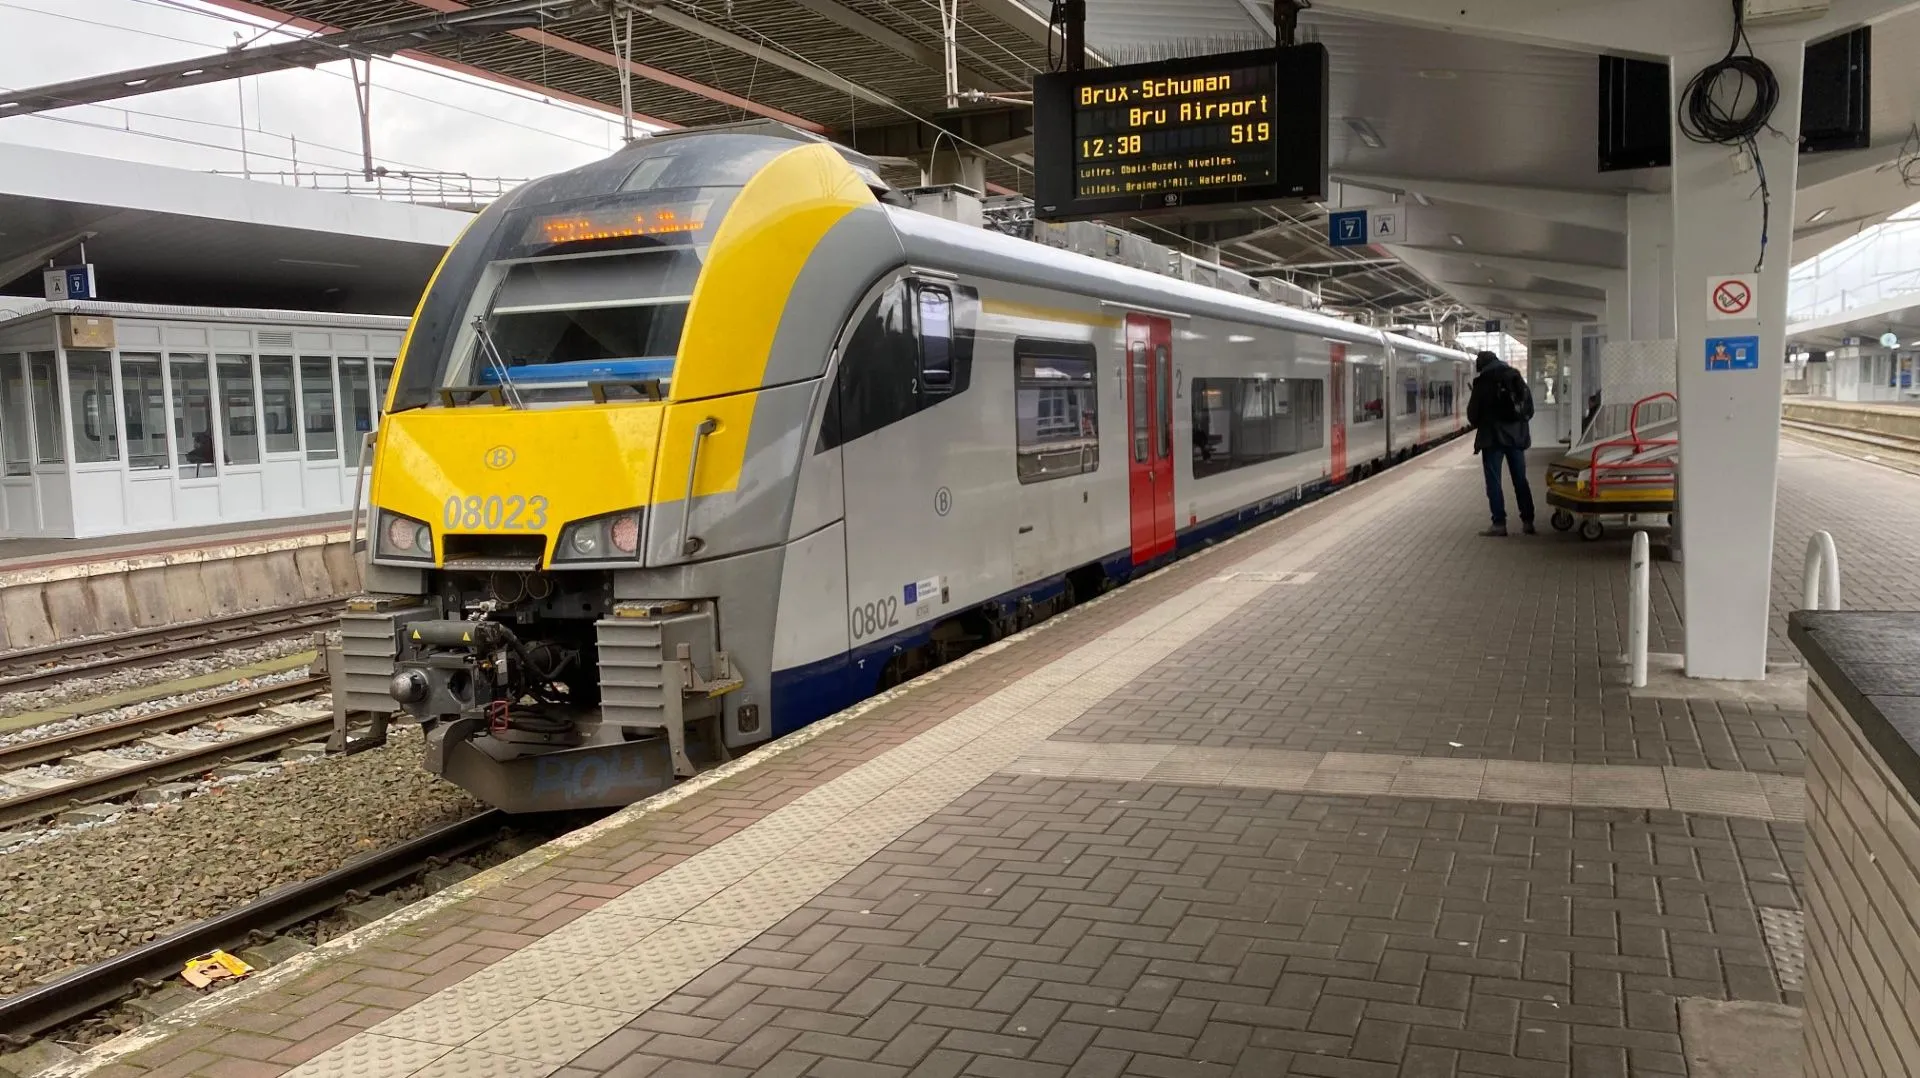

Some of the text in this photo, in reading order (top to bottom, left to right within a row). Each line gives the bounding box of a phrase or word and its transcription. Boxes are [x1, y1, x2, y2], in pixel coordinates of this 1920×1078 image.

[1081, 75, 1231, 106] Brux-Schuman
[1129, 95, 1268, 127] Bru Airport
[1082, 122, 1270, 159] 12:38 S19
[1346, 225, 1355, 237] 7
[1380, 222, 1389, 233] A
[54, 282, 61, 292] A
[74, 281, 80, 291] 9
[911, 377, 918, 394] 2
[1175, 368, 1183, 399] 2
[443, 494, 549, 530] 08023
[852, 595, 899, 640] 0802
